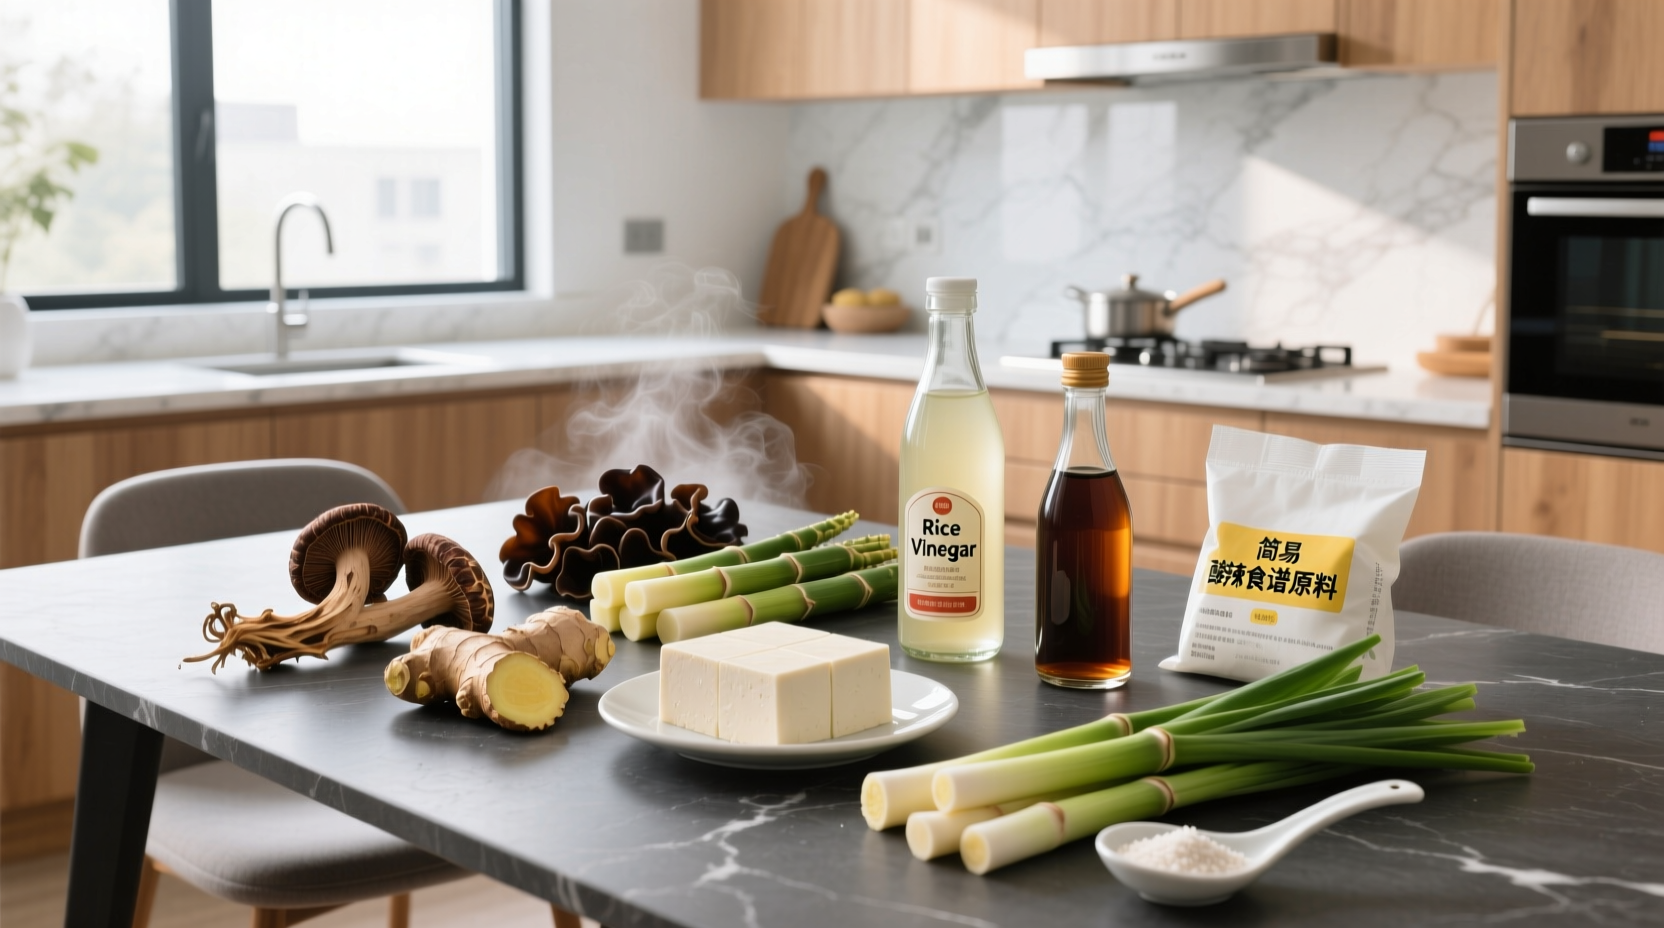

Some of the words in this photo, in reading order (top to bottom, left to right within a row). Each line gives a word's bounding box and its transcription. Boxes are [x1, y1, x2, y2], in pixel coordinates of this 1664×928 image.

[923, 518, 961, 536] Rice
[911, 537, 977, 562] Vinegar
[1256, 536, 1302, 564] 简易
